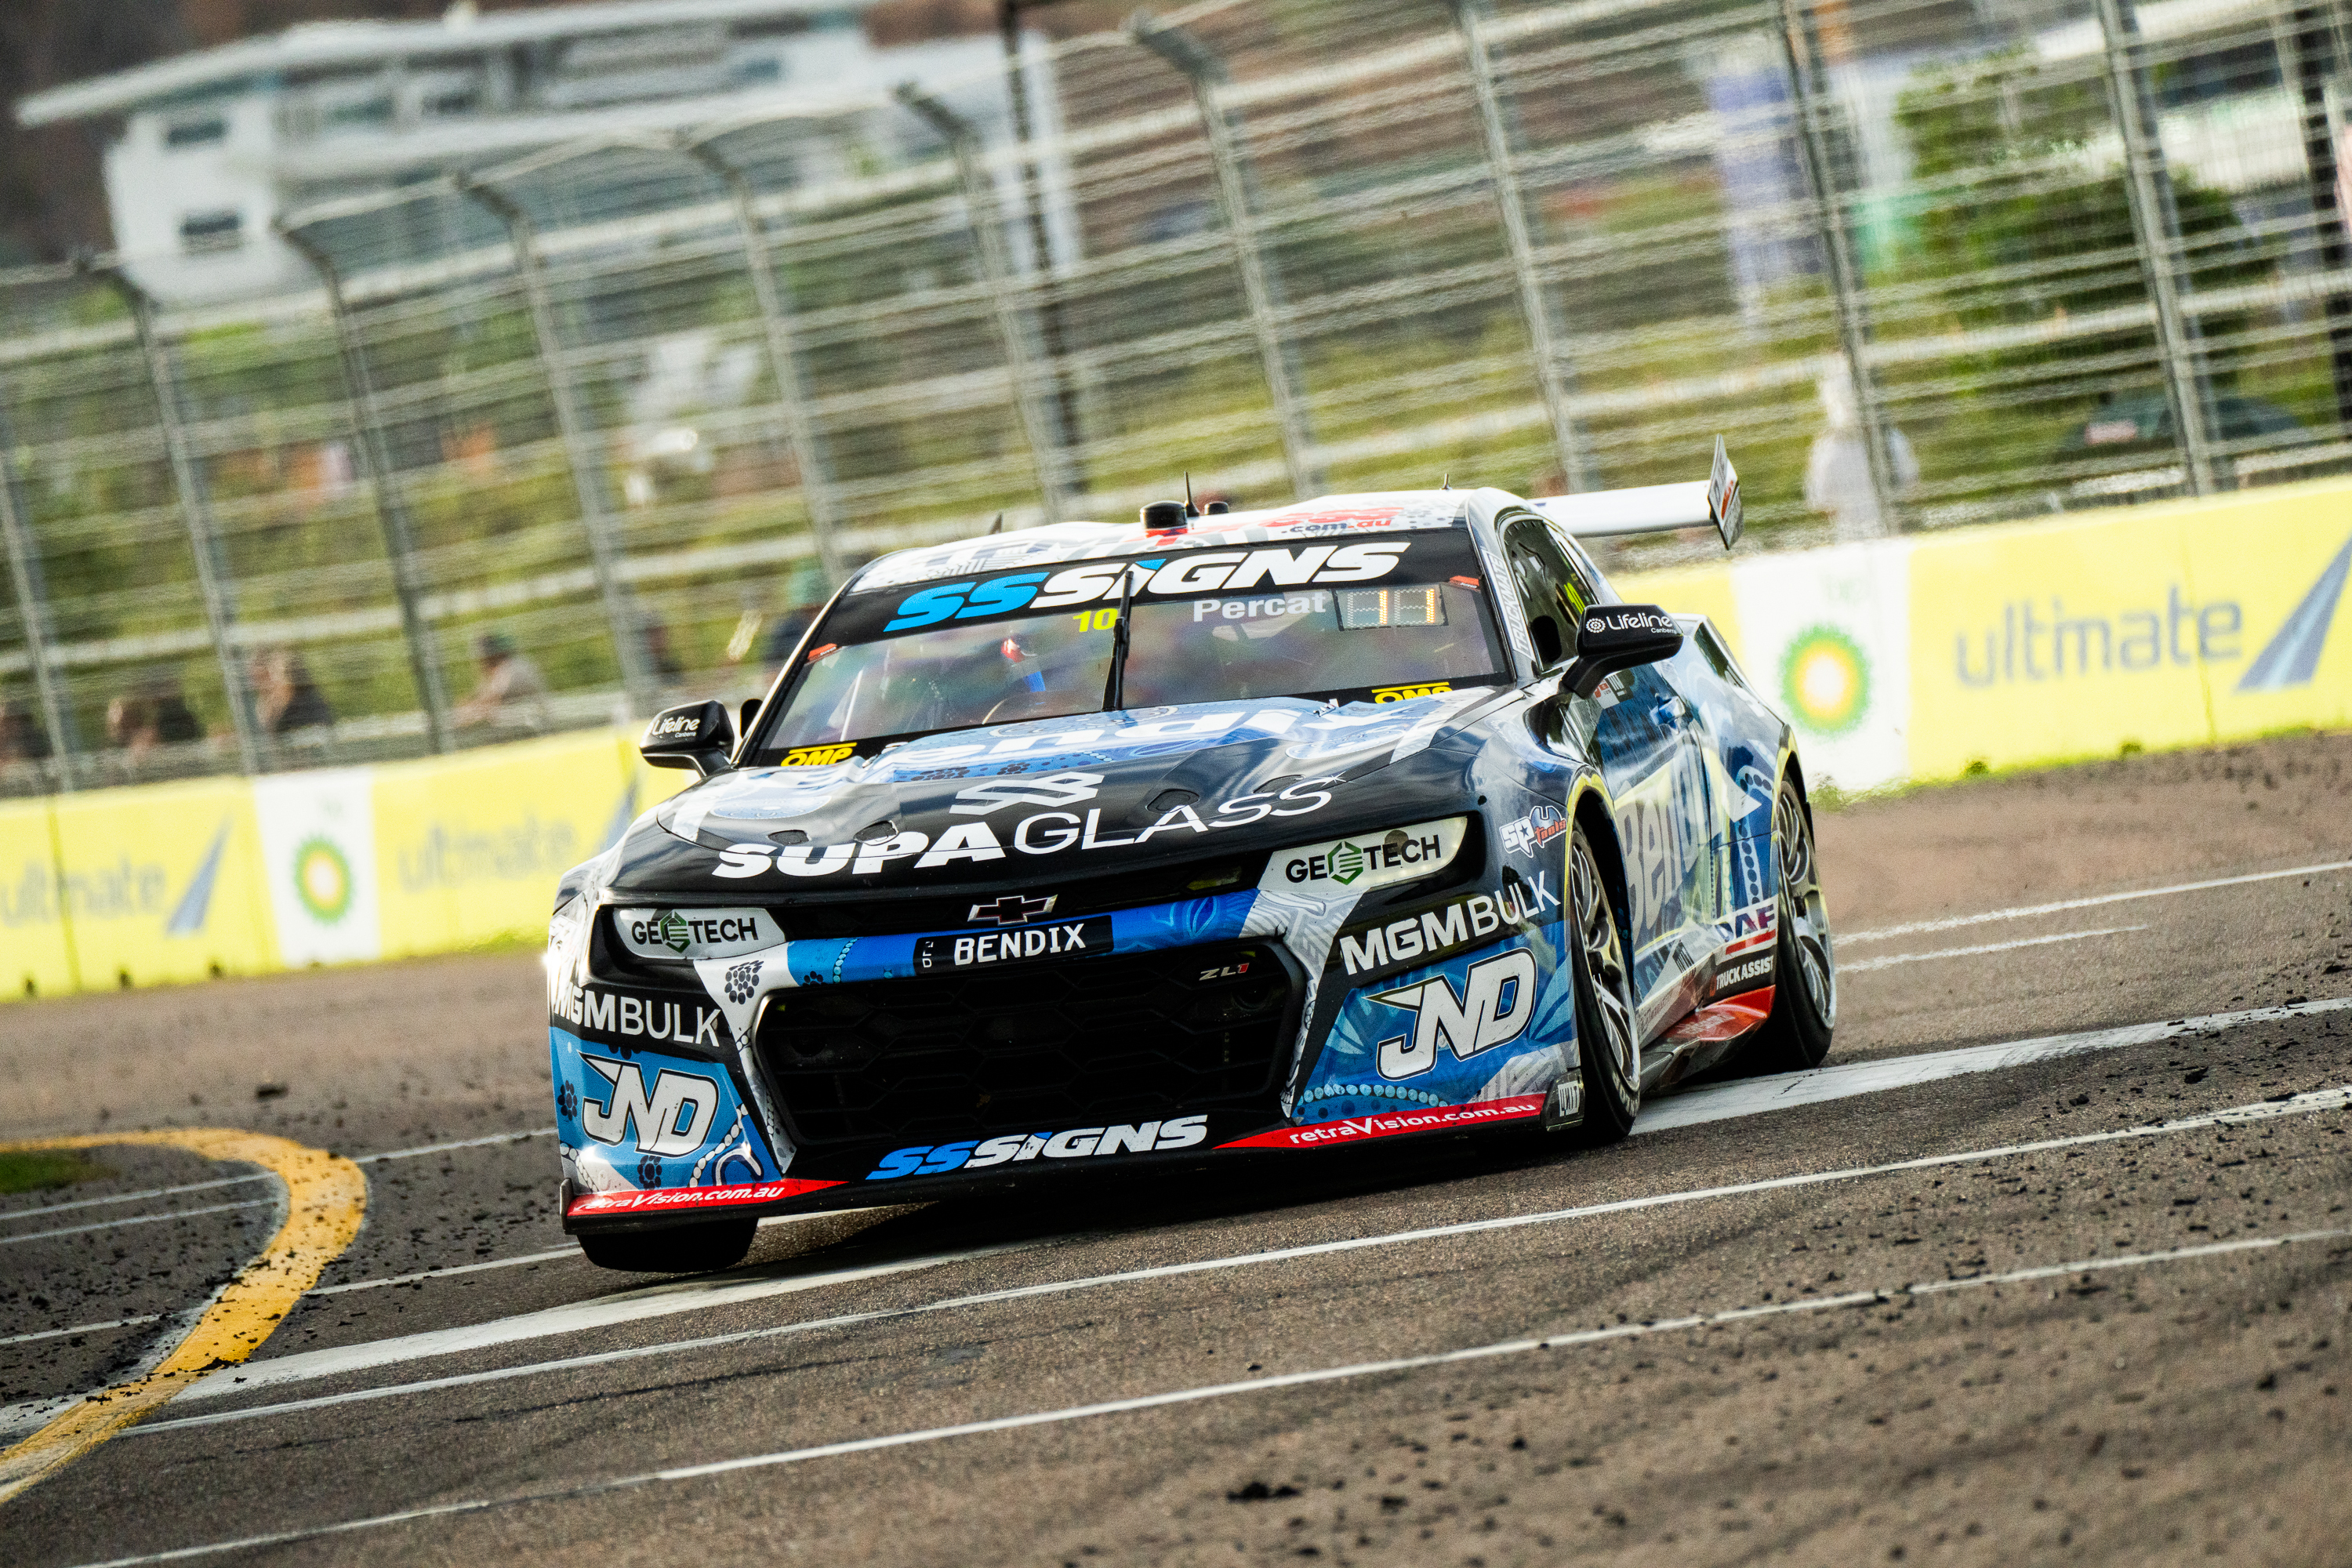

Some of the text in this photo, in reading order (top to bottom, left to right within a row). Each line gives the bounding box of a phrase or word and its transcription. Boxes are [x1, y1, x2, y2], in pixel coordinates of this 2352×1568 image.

[1073, 608, 1118, 633] 10
[1193, 593, 1327, 622] Percat
[1606, 612, 1673, 630] Lifeline
[1954, 583, 2243, 690] ultimate
[652, 716, 700, 735] Lifeline
[780, 747, 853, 767] OMP
[954, 923, 1086, 965] BENDIX
[1199, 962, 1250, 981] ZL1
[1363, 947, 1539, 1081] JND
[577, 1049, 720, 1158] JND
[1290, 1101, 1537, 1145] retraVision.com.au
